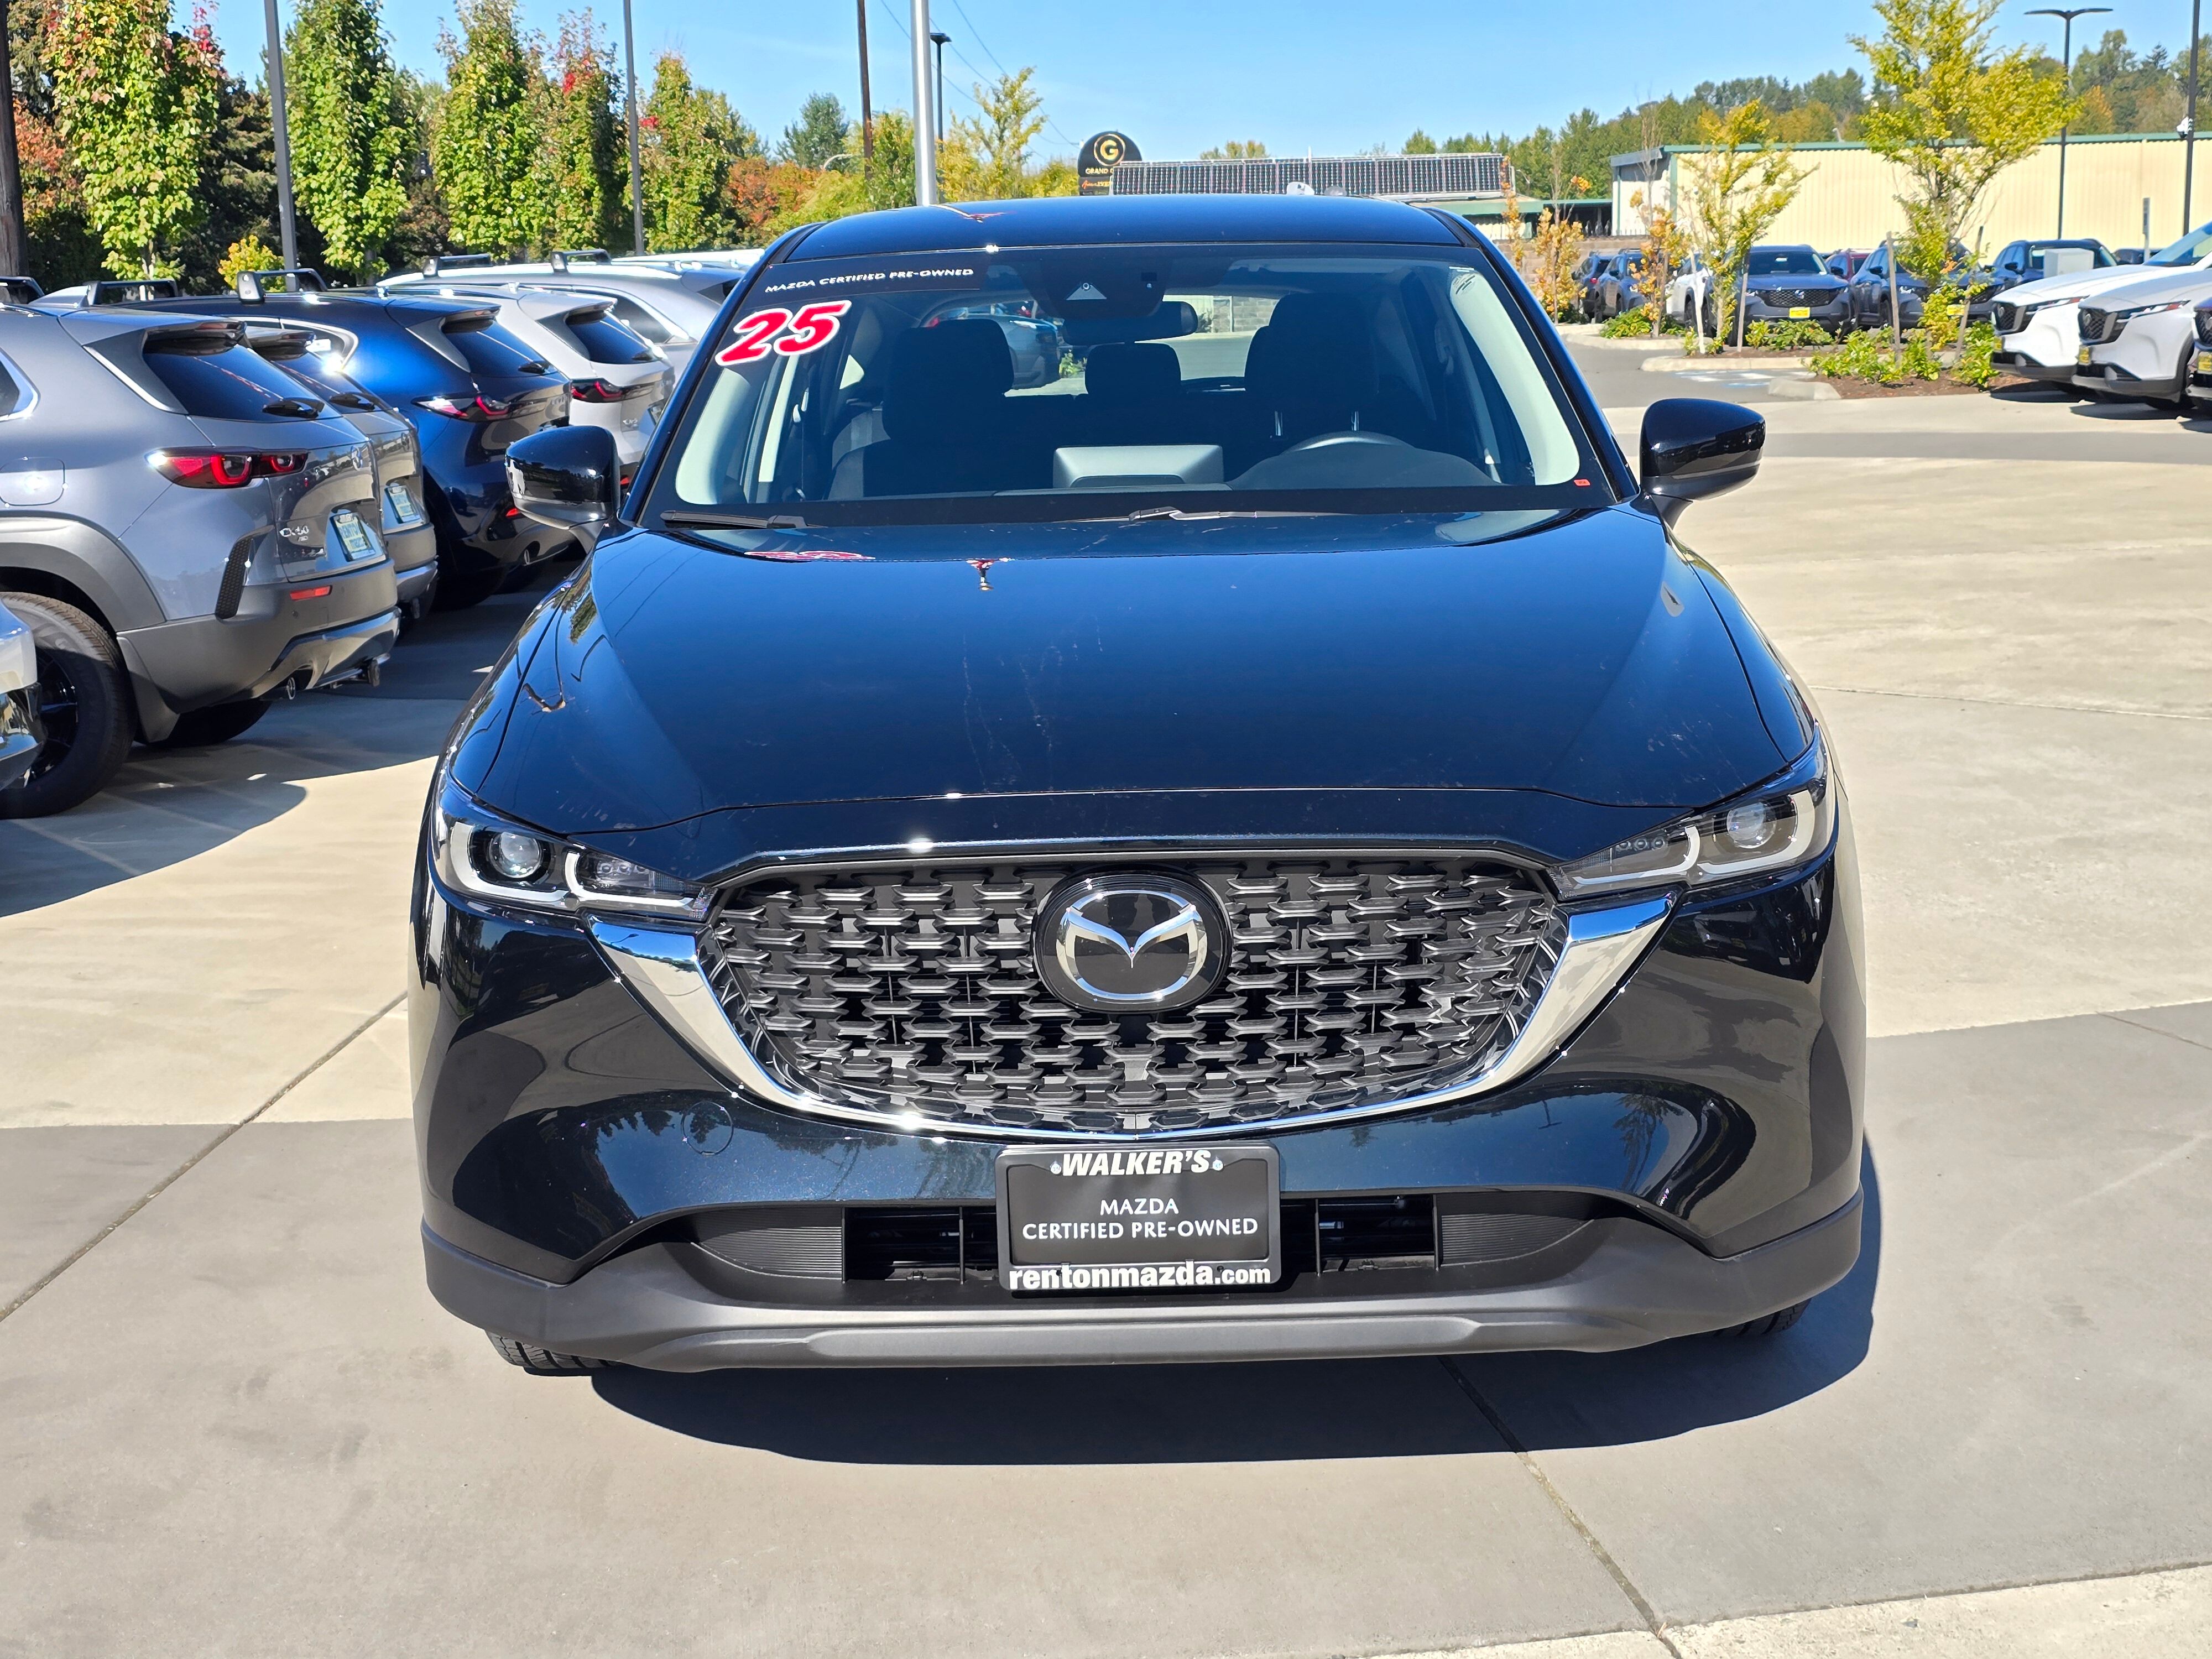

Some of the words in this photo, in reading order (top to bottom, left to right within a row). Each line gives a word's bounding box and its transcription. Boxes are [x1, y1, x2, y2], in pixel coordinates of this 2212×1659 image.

[1100, 140, 1118, 160] G
[765, 280, 815, 293] MAZDA
[819, 273, 886, 286] CERTIFIED
[889, 269, 974, 279] PRE-OWNED
[714, 300, 852, 367] 25
[1062, 1150, 1211, 1176] WALKER'S
[1100, 1198, 1179, 1216] MAZDA
[1022, 1222, 1124, 1240] CERTIFIED
[1131, 1218, 1259, 1238] PRE-OWNED
[1009, 1260, 1271, 1290] rentonmazda.com
